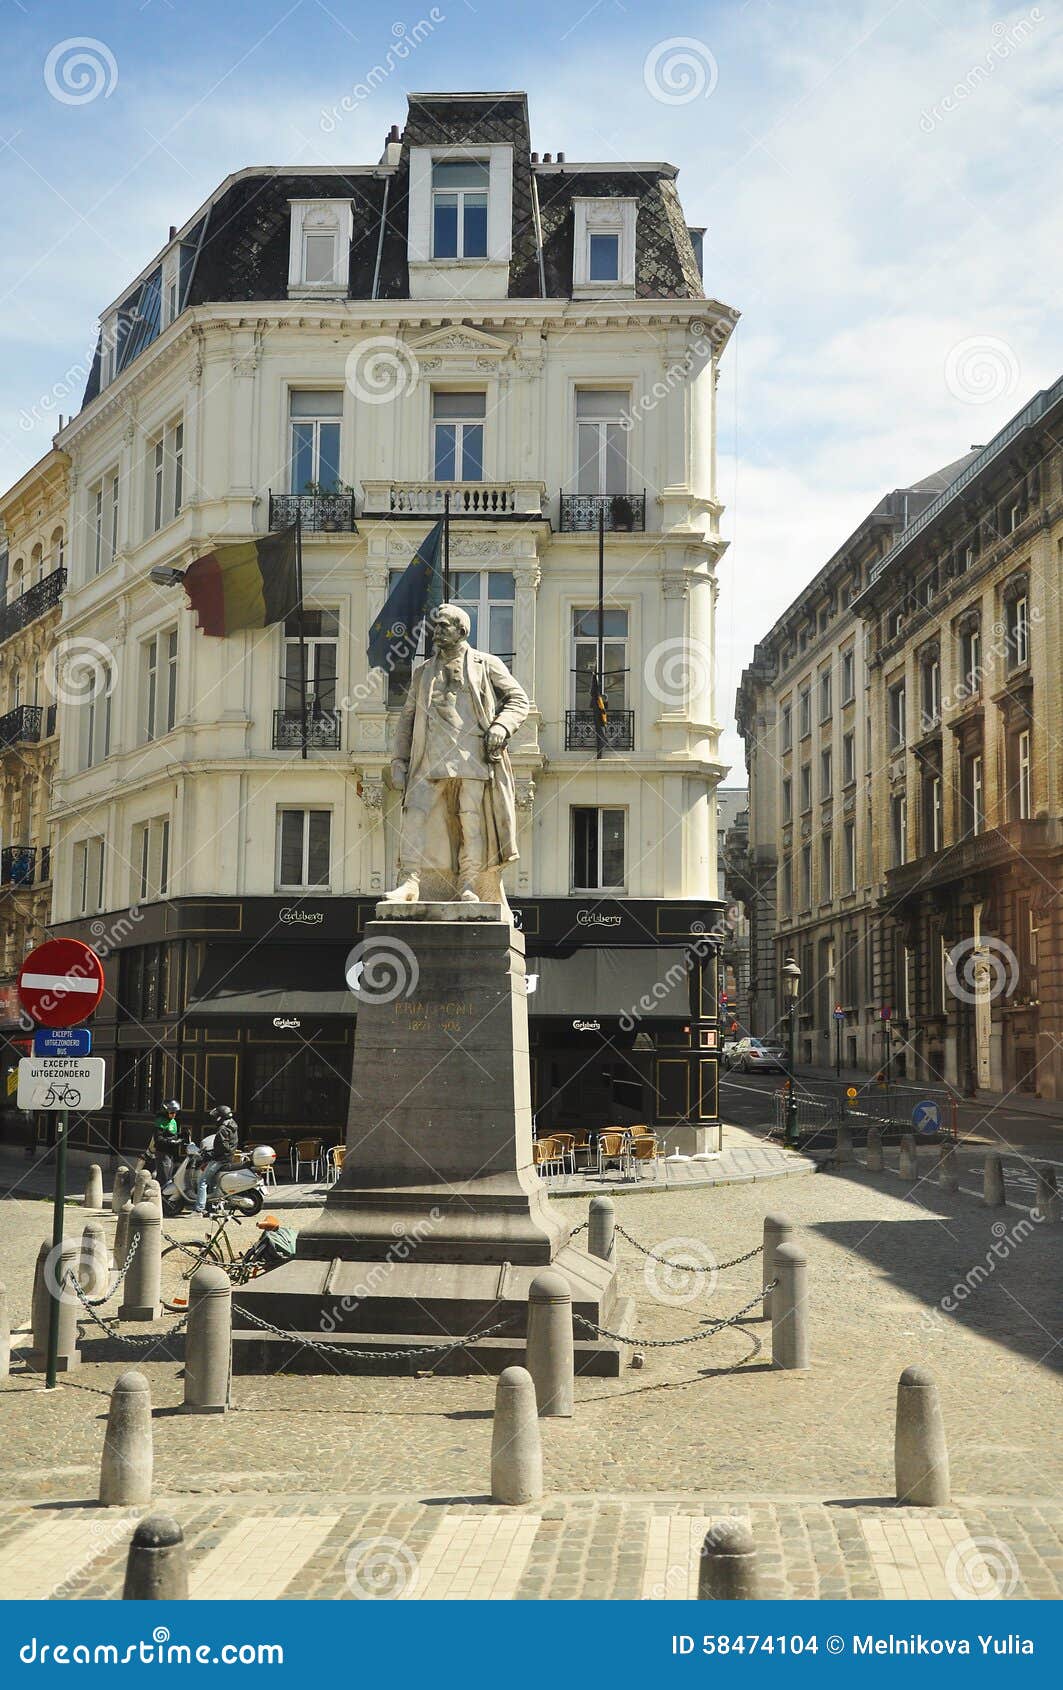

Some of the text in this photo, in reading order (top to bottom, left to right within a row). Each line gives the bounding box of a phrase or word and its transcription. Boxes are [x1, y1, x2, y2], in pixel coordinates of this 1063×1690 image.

[279, 907, 323, 925] Carlsberg
[576, 909, 621, 927] Carlsberg
[573, 1020, 601, 1031] Carlsberg
[52, 1030, 73, 1038] EXCEPTE
[31, 1069, 90, 1078] UITGEZONDERD
